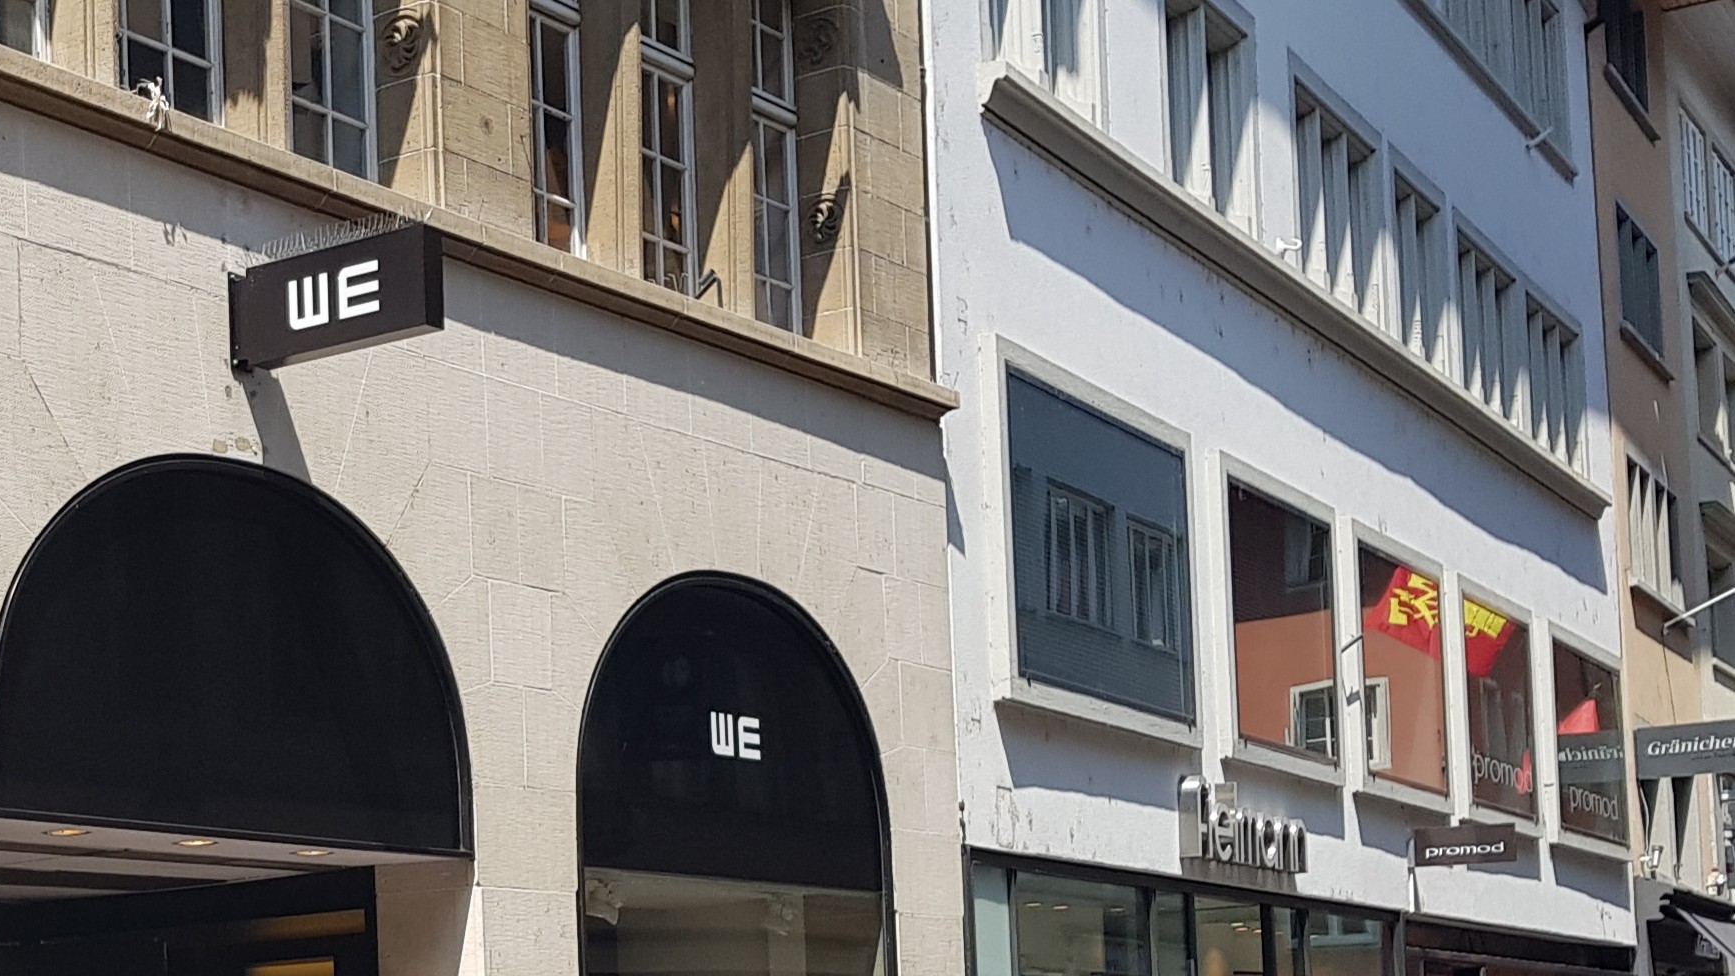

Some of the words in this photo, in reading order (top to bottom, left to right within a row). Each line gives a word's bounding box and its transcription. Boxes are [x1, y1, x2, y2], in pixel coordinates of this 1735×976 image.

[288, 259, 380, 330] WE
[710, 711, 761, 760] WE
[1647, 735, 1735, 756] Gräniche
[1473, 753, 1533, 793] promod
[1569, 785, 1619, 820] promod
[1425, 841, 1505, 859] promod
